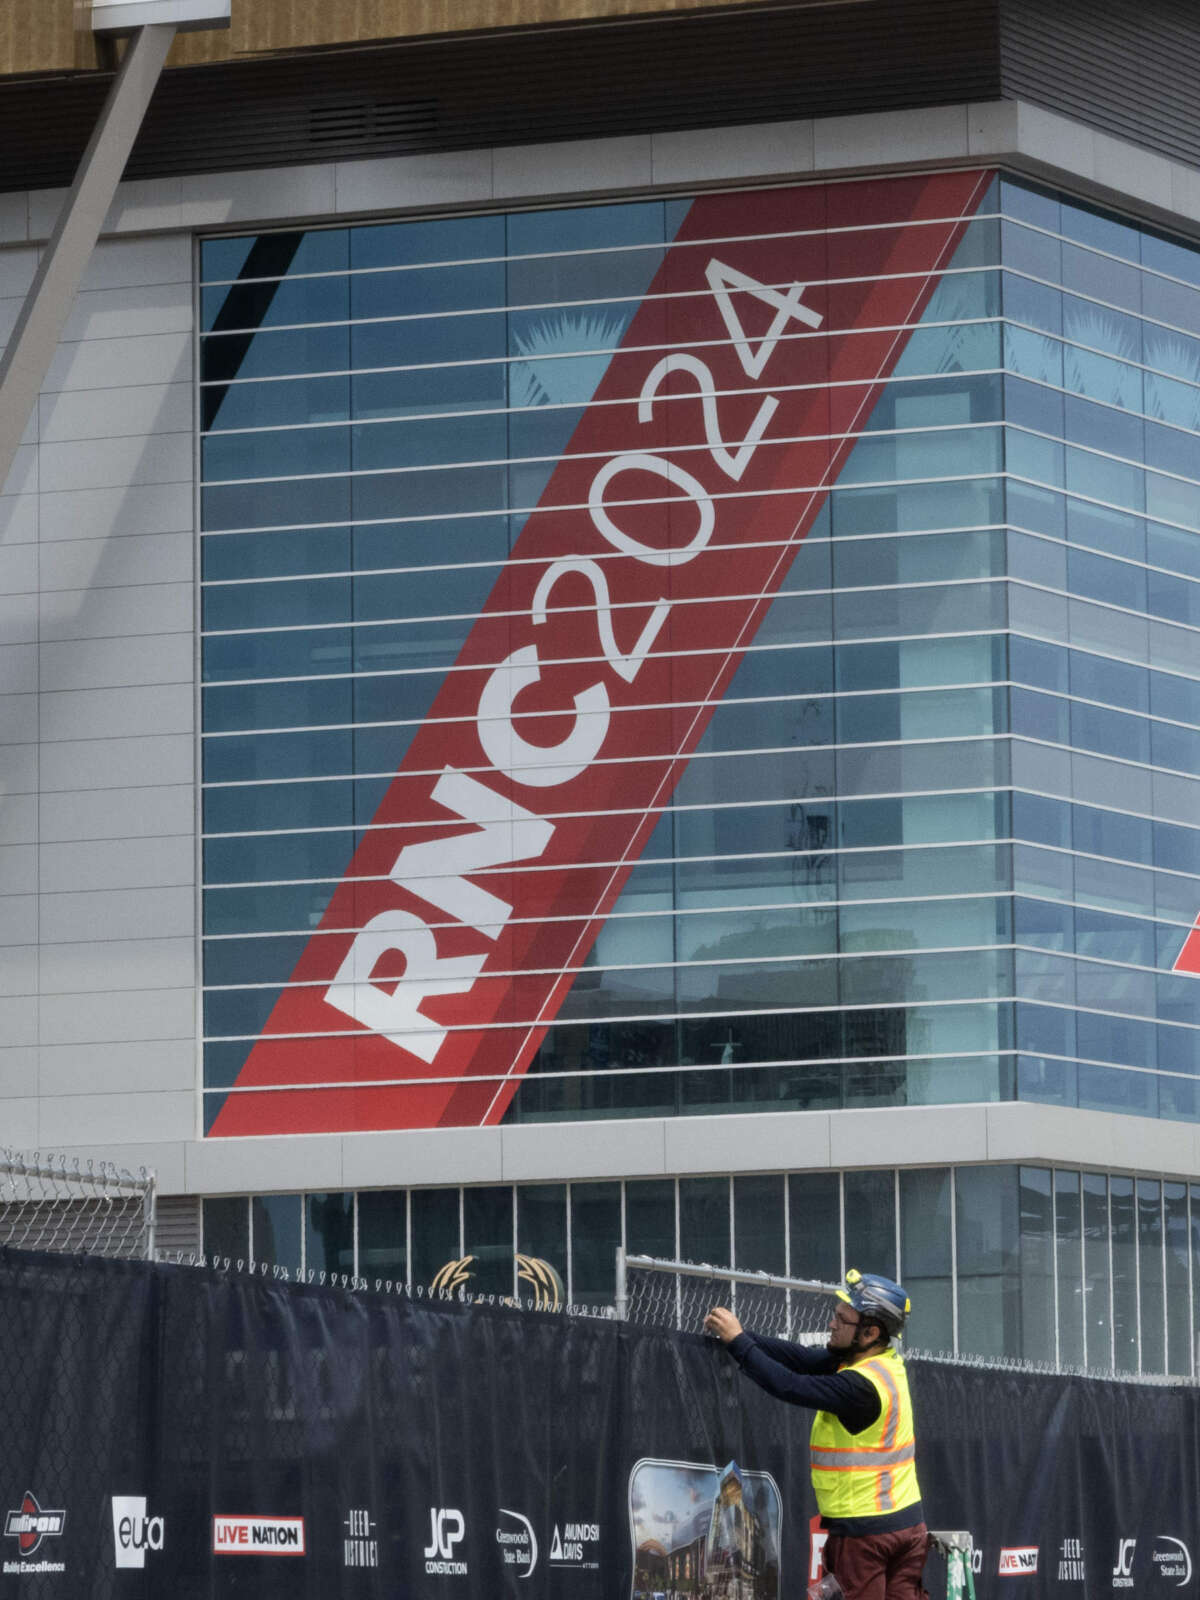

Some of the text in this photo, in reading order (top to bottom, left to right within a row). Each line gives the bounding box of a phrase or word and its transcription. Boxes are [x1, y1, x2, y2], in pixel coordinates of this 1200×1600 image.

[217, 1525, 298, 1545] LIVE NATION
[424, 1507, 465, 1559] JCP
